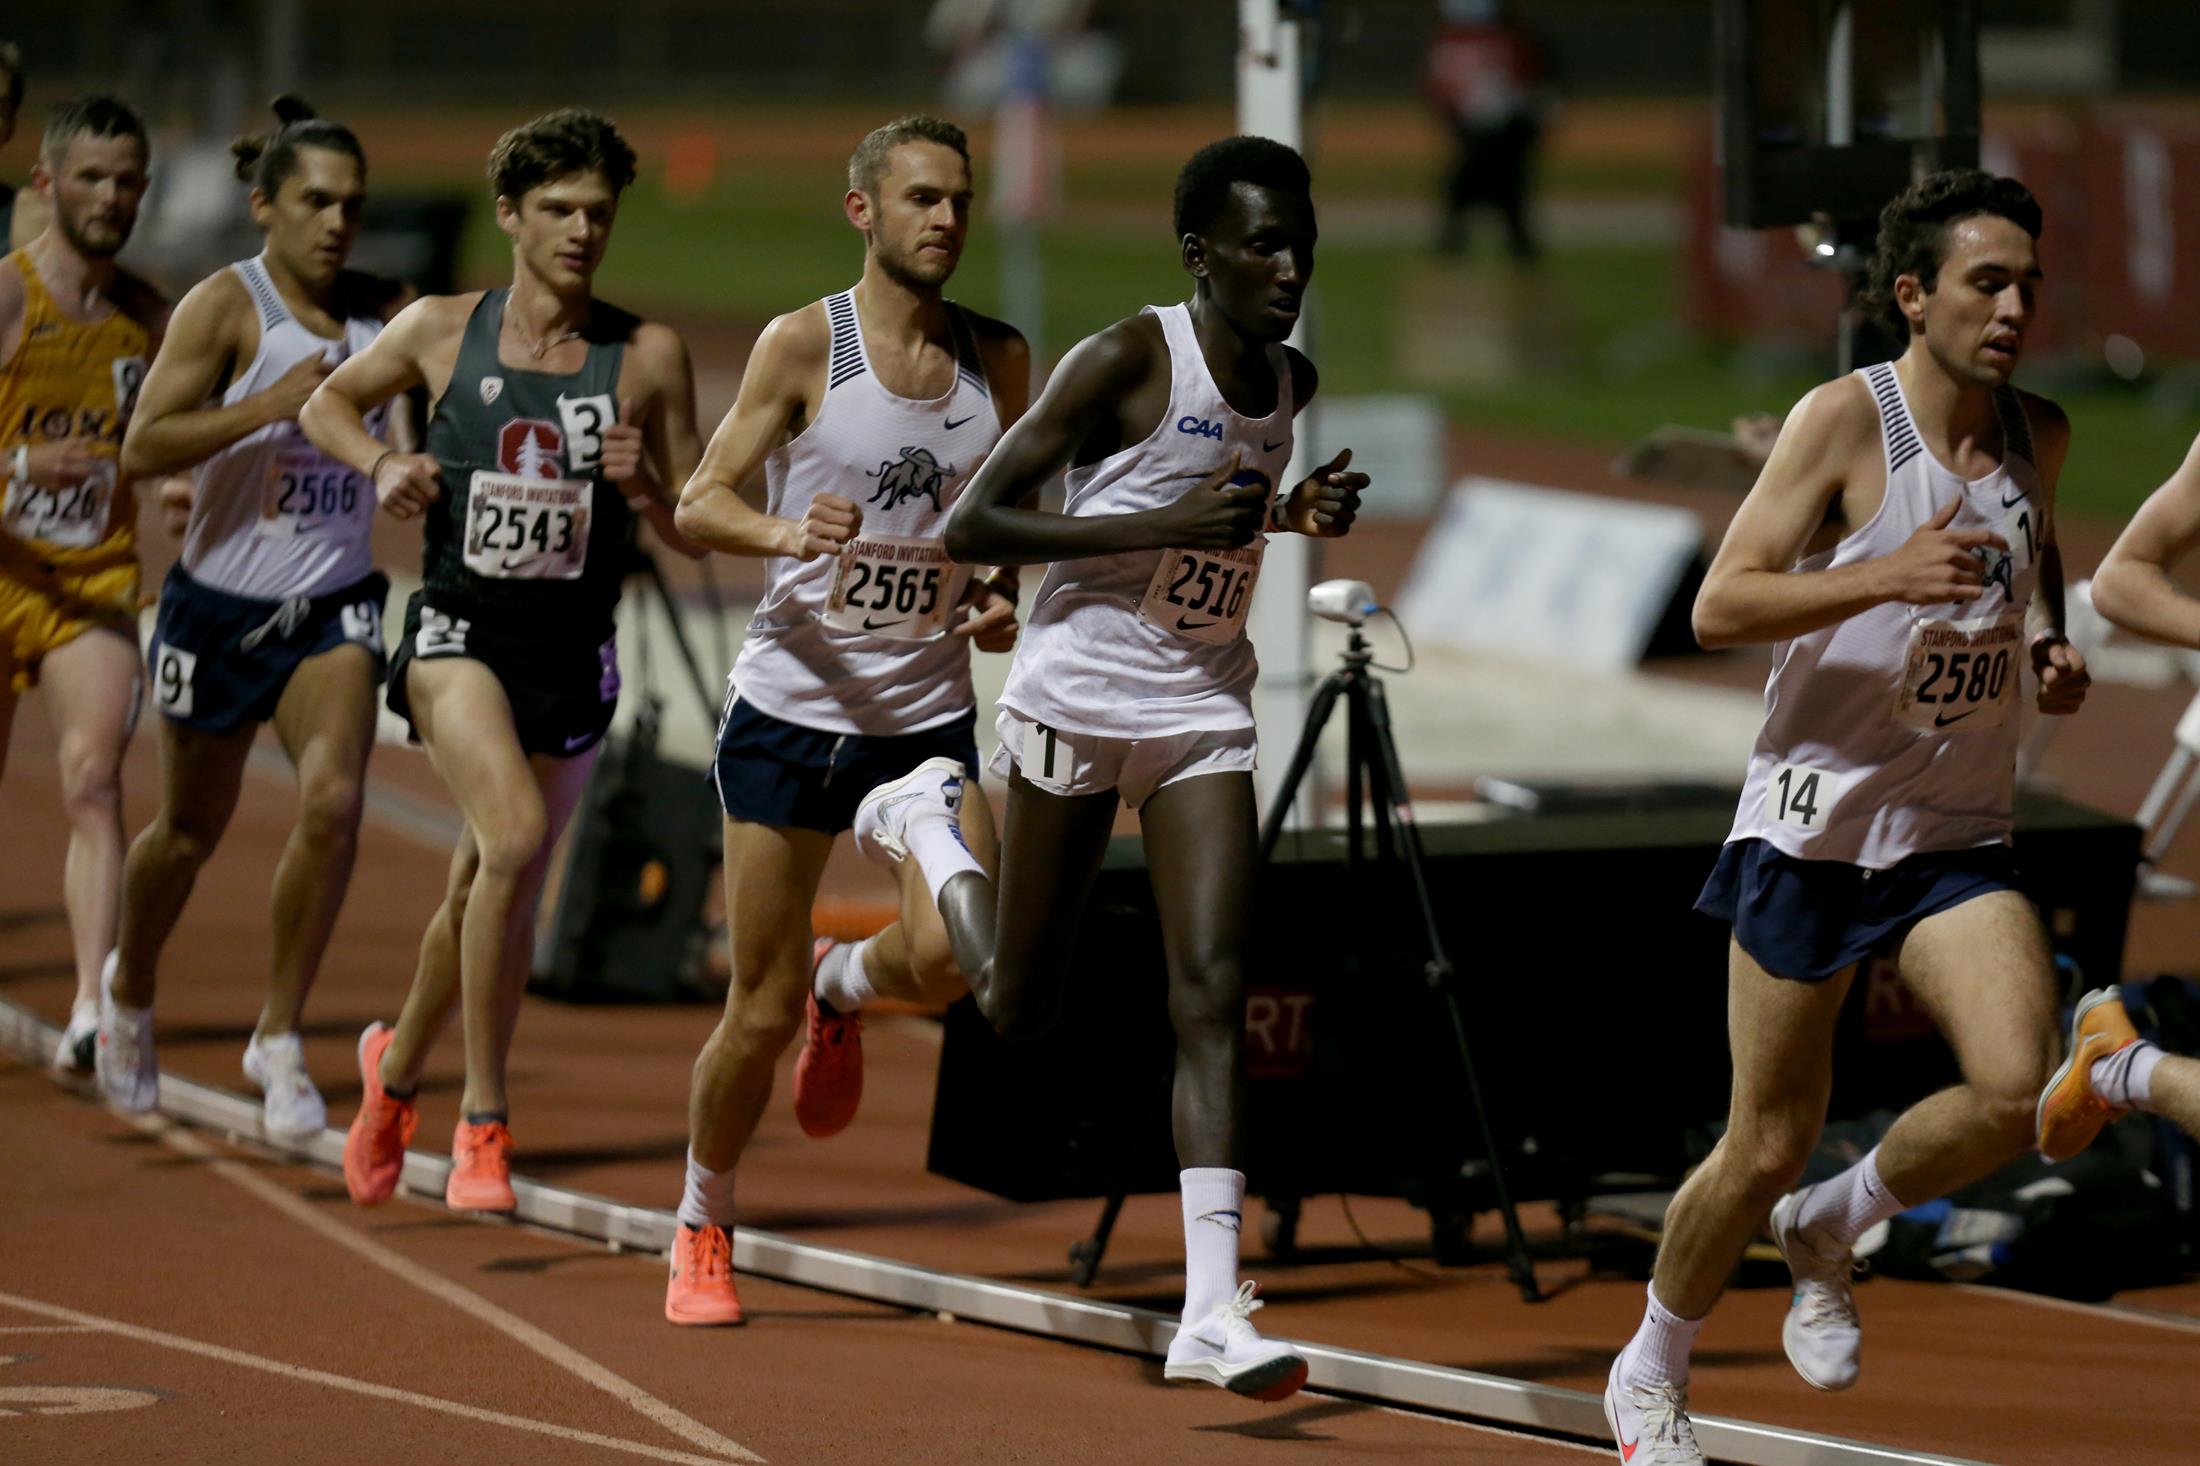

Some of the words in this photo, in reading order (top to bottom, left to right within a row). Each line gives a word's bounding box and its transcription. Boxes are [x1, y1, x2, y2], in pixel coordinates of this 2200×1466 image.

[574, 404, 602, 461] 3
[1177, 416, 1223, 441] CAA
[278, 473, 357, 515] 2566
[482, 504, 572, 552] 2543
[847, 540, 896, 561] STANFORD
[846, 562, 940, 614] 2565
[1167, 555, 1249, 618] 2516
[1920, 628, 1969, 648] STANFORD
[162, 655, 181, 704] 9
[1916, 649, 2008, 703] 2580
[1036, 722, 1057, 778] 1
[1778, 767, 1820, 825] 14
